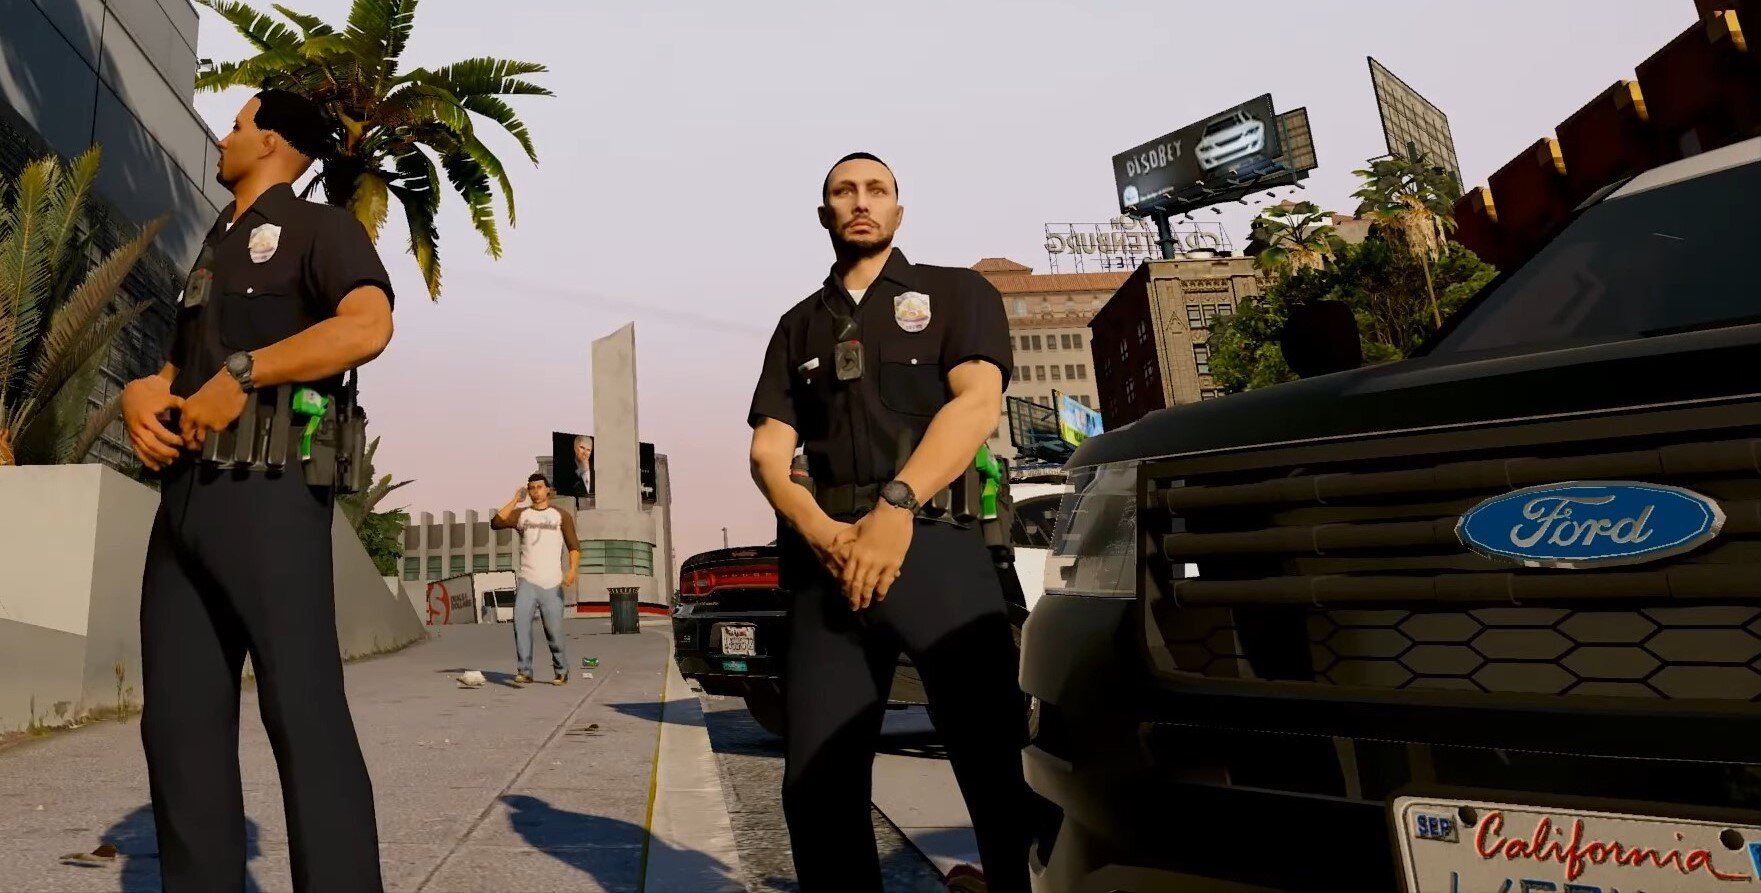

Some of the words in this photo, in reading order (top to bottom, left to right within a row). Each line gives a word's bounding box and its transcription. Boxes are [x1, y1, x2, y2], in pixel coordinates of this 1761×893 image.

[1126, 139, 1181, 177] DISOBEY
[1509, 495, 1655, 548] Ford
[1417, 814, 1452, 838] SEP
[1474, 810, 1752, 881] California
